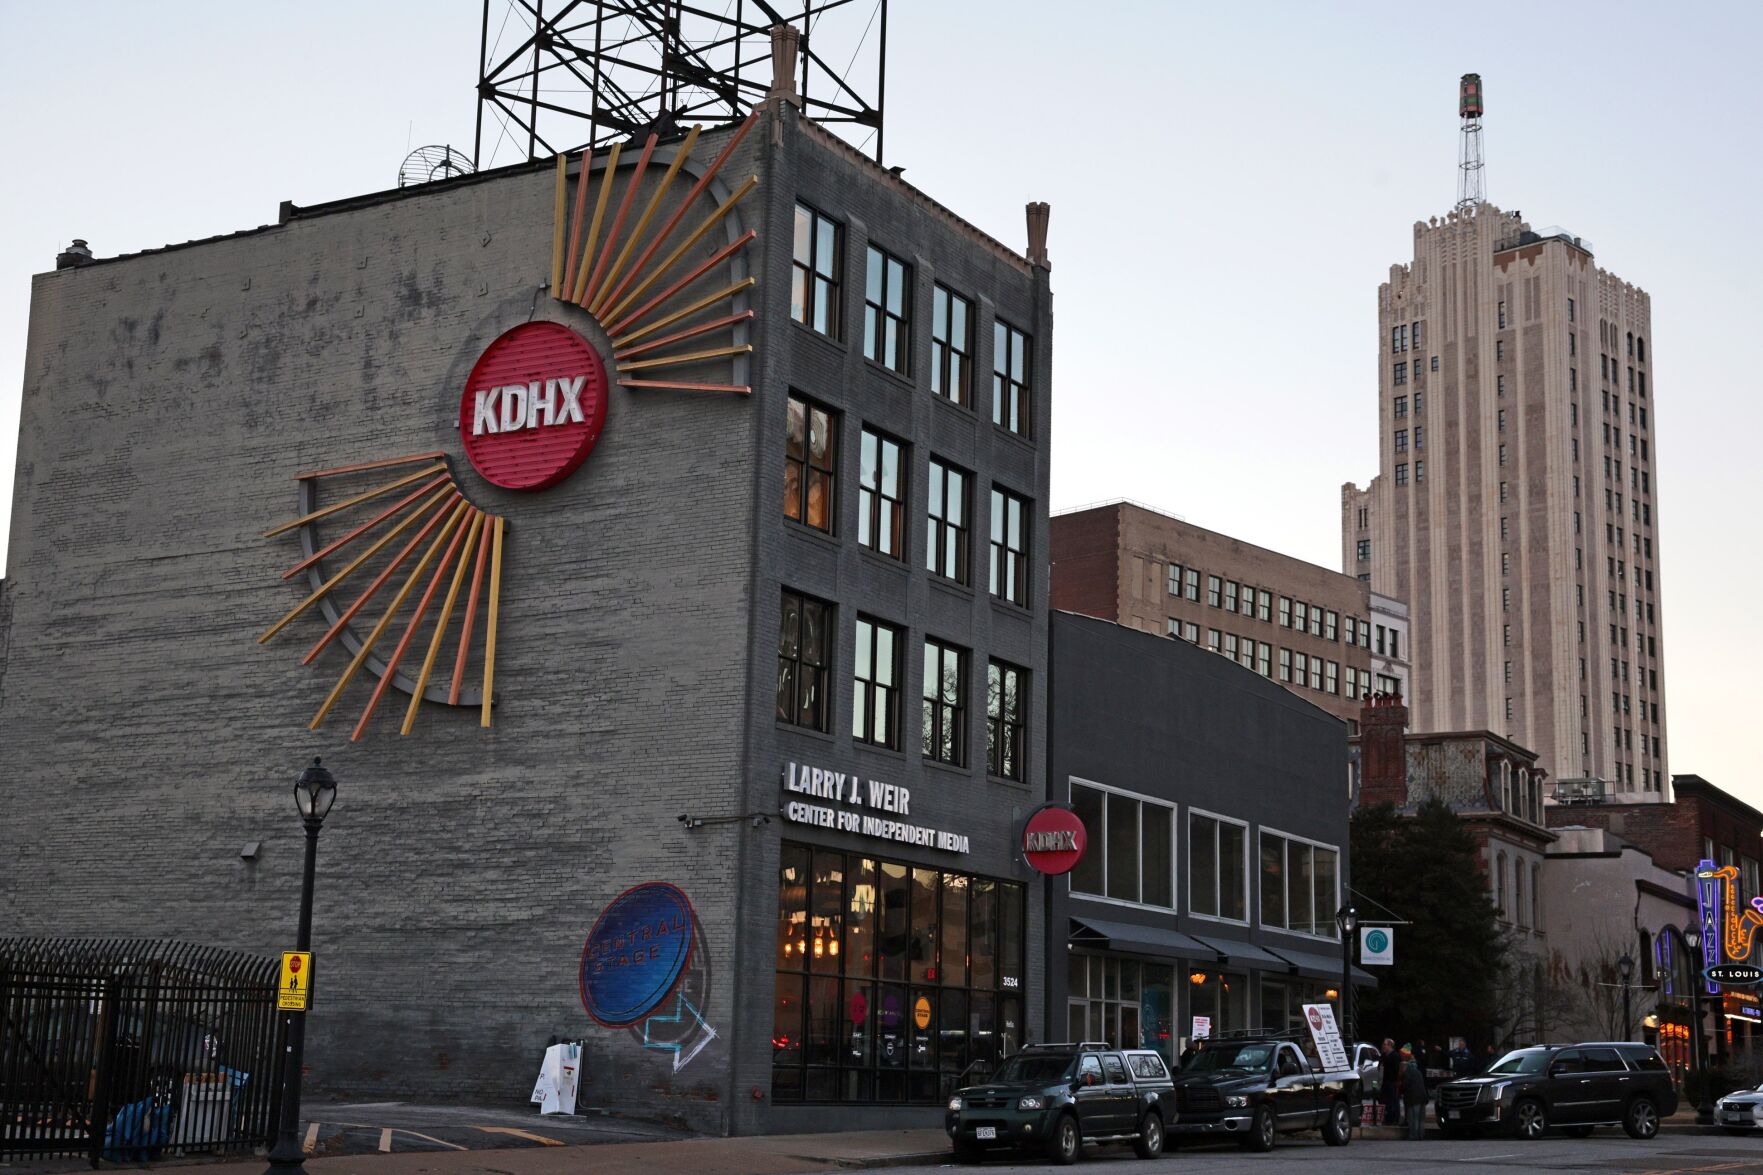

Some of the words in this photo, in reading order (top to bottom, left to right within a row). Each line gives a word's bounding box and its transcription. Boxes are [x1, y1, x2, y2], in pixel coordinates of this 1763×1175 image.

[472, 375, 588, 436] KDHX
[788, 762, 846, 802] LARRY
[848, 776, 863, 805] J.
[868, 780, 911, 815] WEIR
[787, 801, 835, 828] CENTER
[837, 810, 860, 833] FOR
[862, 816, 936, 847] INDEPENDENT
[937, 831, 970, 854] MEDIA
[1025, 830, 1078, 853] KDHX
[587, 914, 687, 960] CENTRAL
[1702, 882, 1716, 963] JAZZ
[290, 960, 301, 968] STOP
[592, 943, 662, 975] STAGE
[1711, 970, 1724, 978] ST.
[1729, 970, 1761, 978] LOUIS
[1002, 976, 1019, 987] 3524
